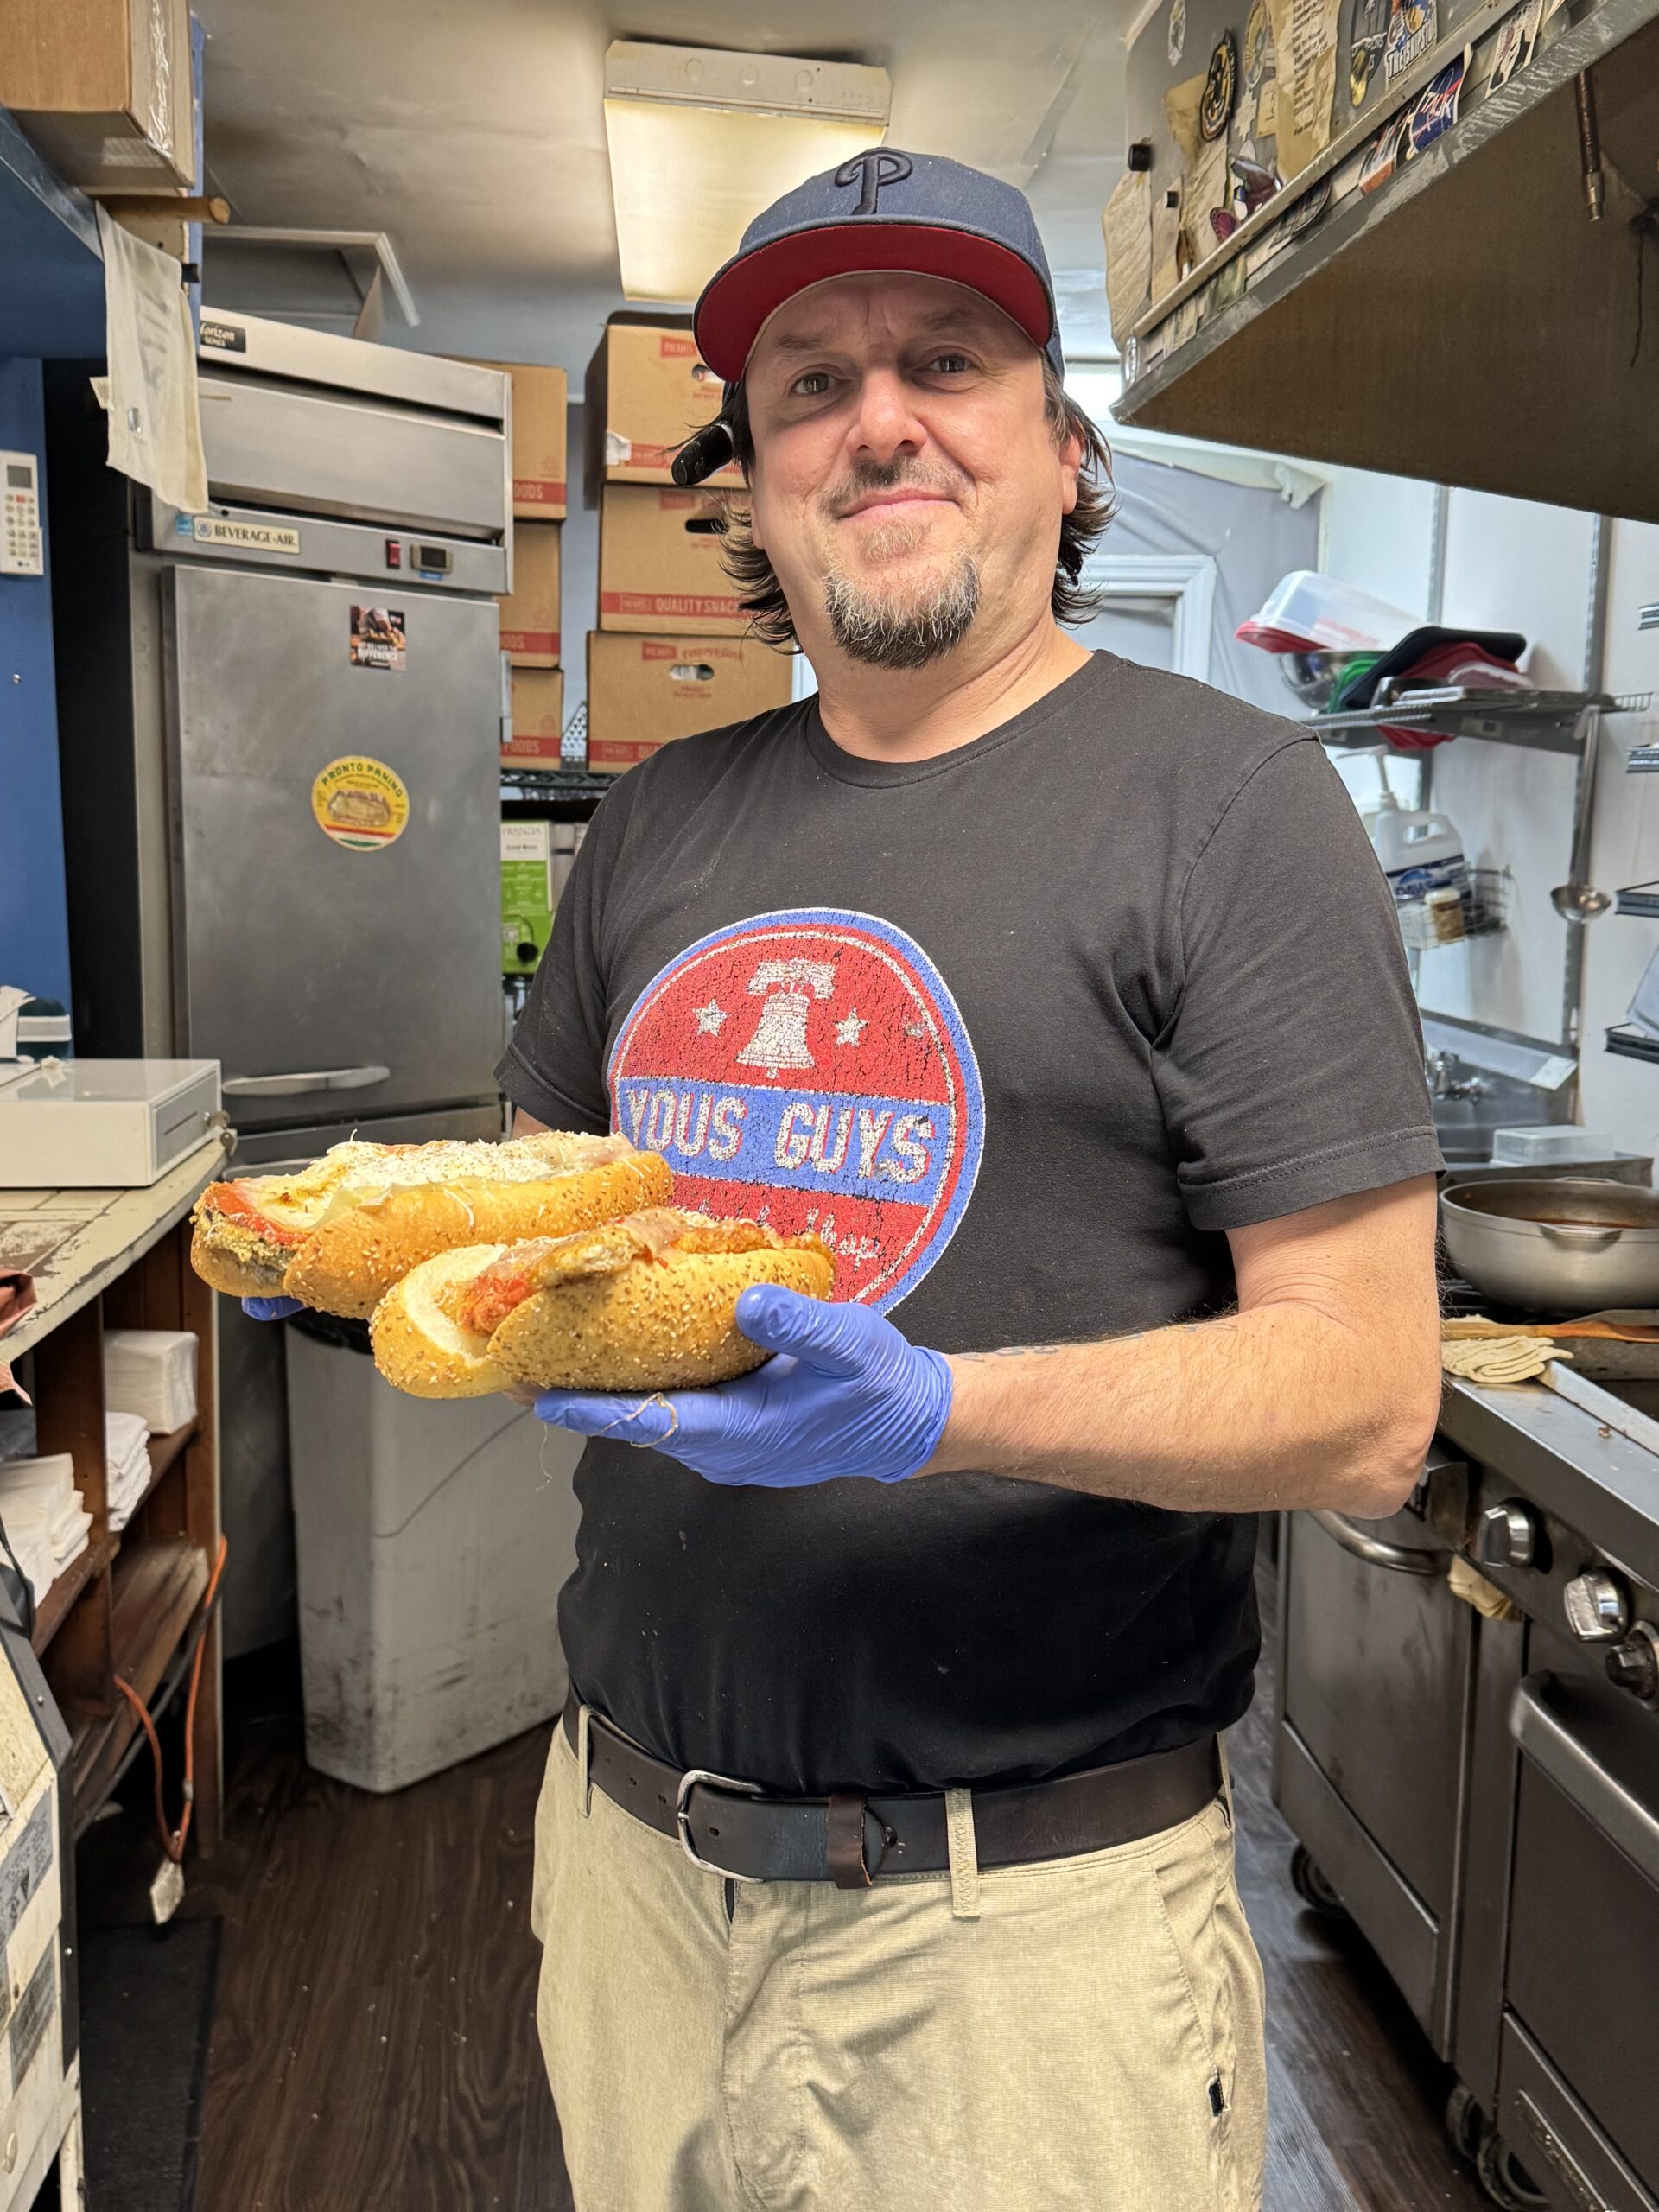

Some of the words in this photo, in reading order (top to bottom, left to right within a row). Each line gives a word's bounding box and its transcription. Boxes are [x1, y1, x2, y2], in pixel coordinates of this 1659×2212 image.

[835, 146, 913, 216] P
[513, 483, 544, 500] OODS
[214, 524, 296, 546] BEVERAGE-AIR
[654, 595, 704, 613] QUALITY
[704, 599, 739, 614] SNAC
[505, 633, 525, 649] ODS
[321, 762, 364, 786] PRONTO
[626, 1089, 748, 1161] YOUS
[772, 1102, 936, 1185] GUYS
